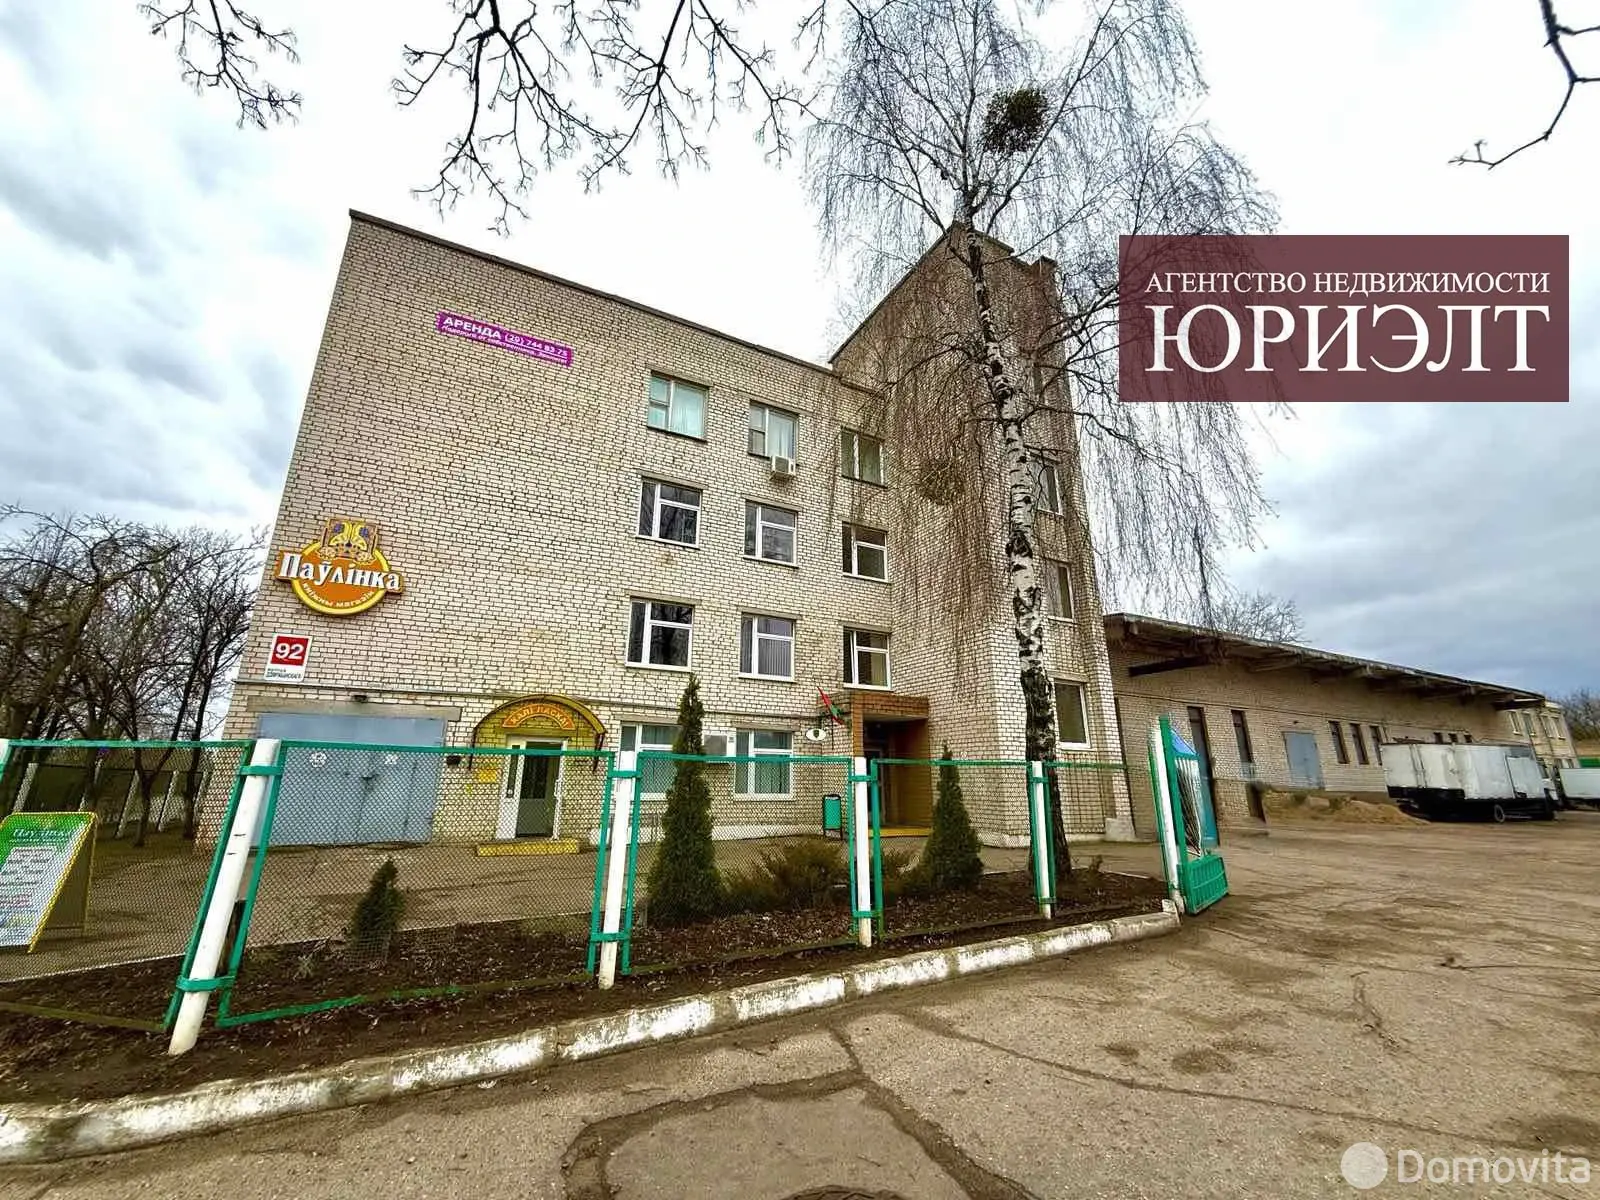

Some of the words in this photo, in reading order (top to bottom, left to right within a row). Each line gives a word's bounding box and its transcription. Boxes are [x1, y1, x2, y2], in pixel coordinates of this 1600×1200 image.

[443, 317, 502, 339] АРЕНДА
[279, 552, 400, 591] Паўлінка
[275, 643, 304, 660] 92
